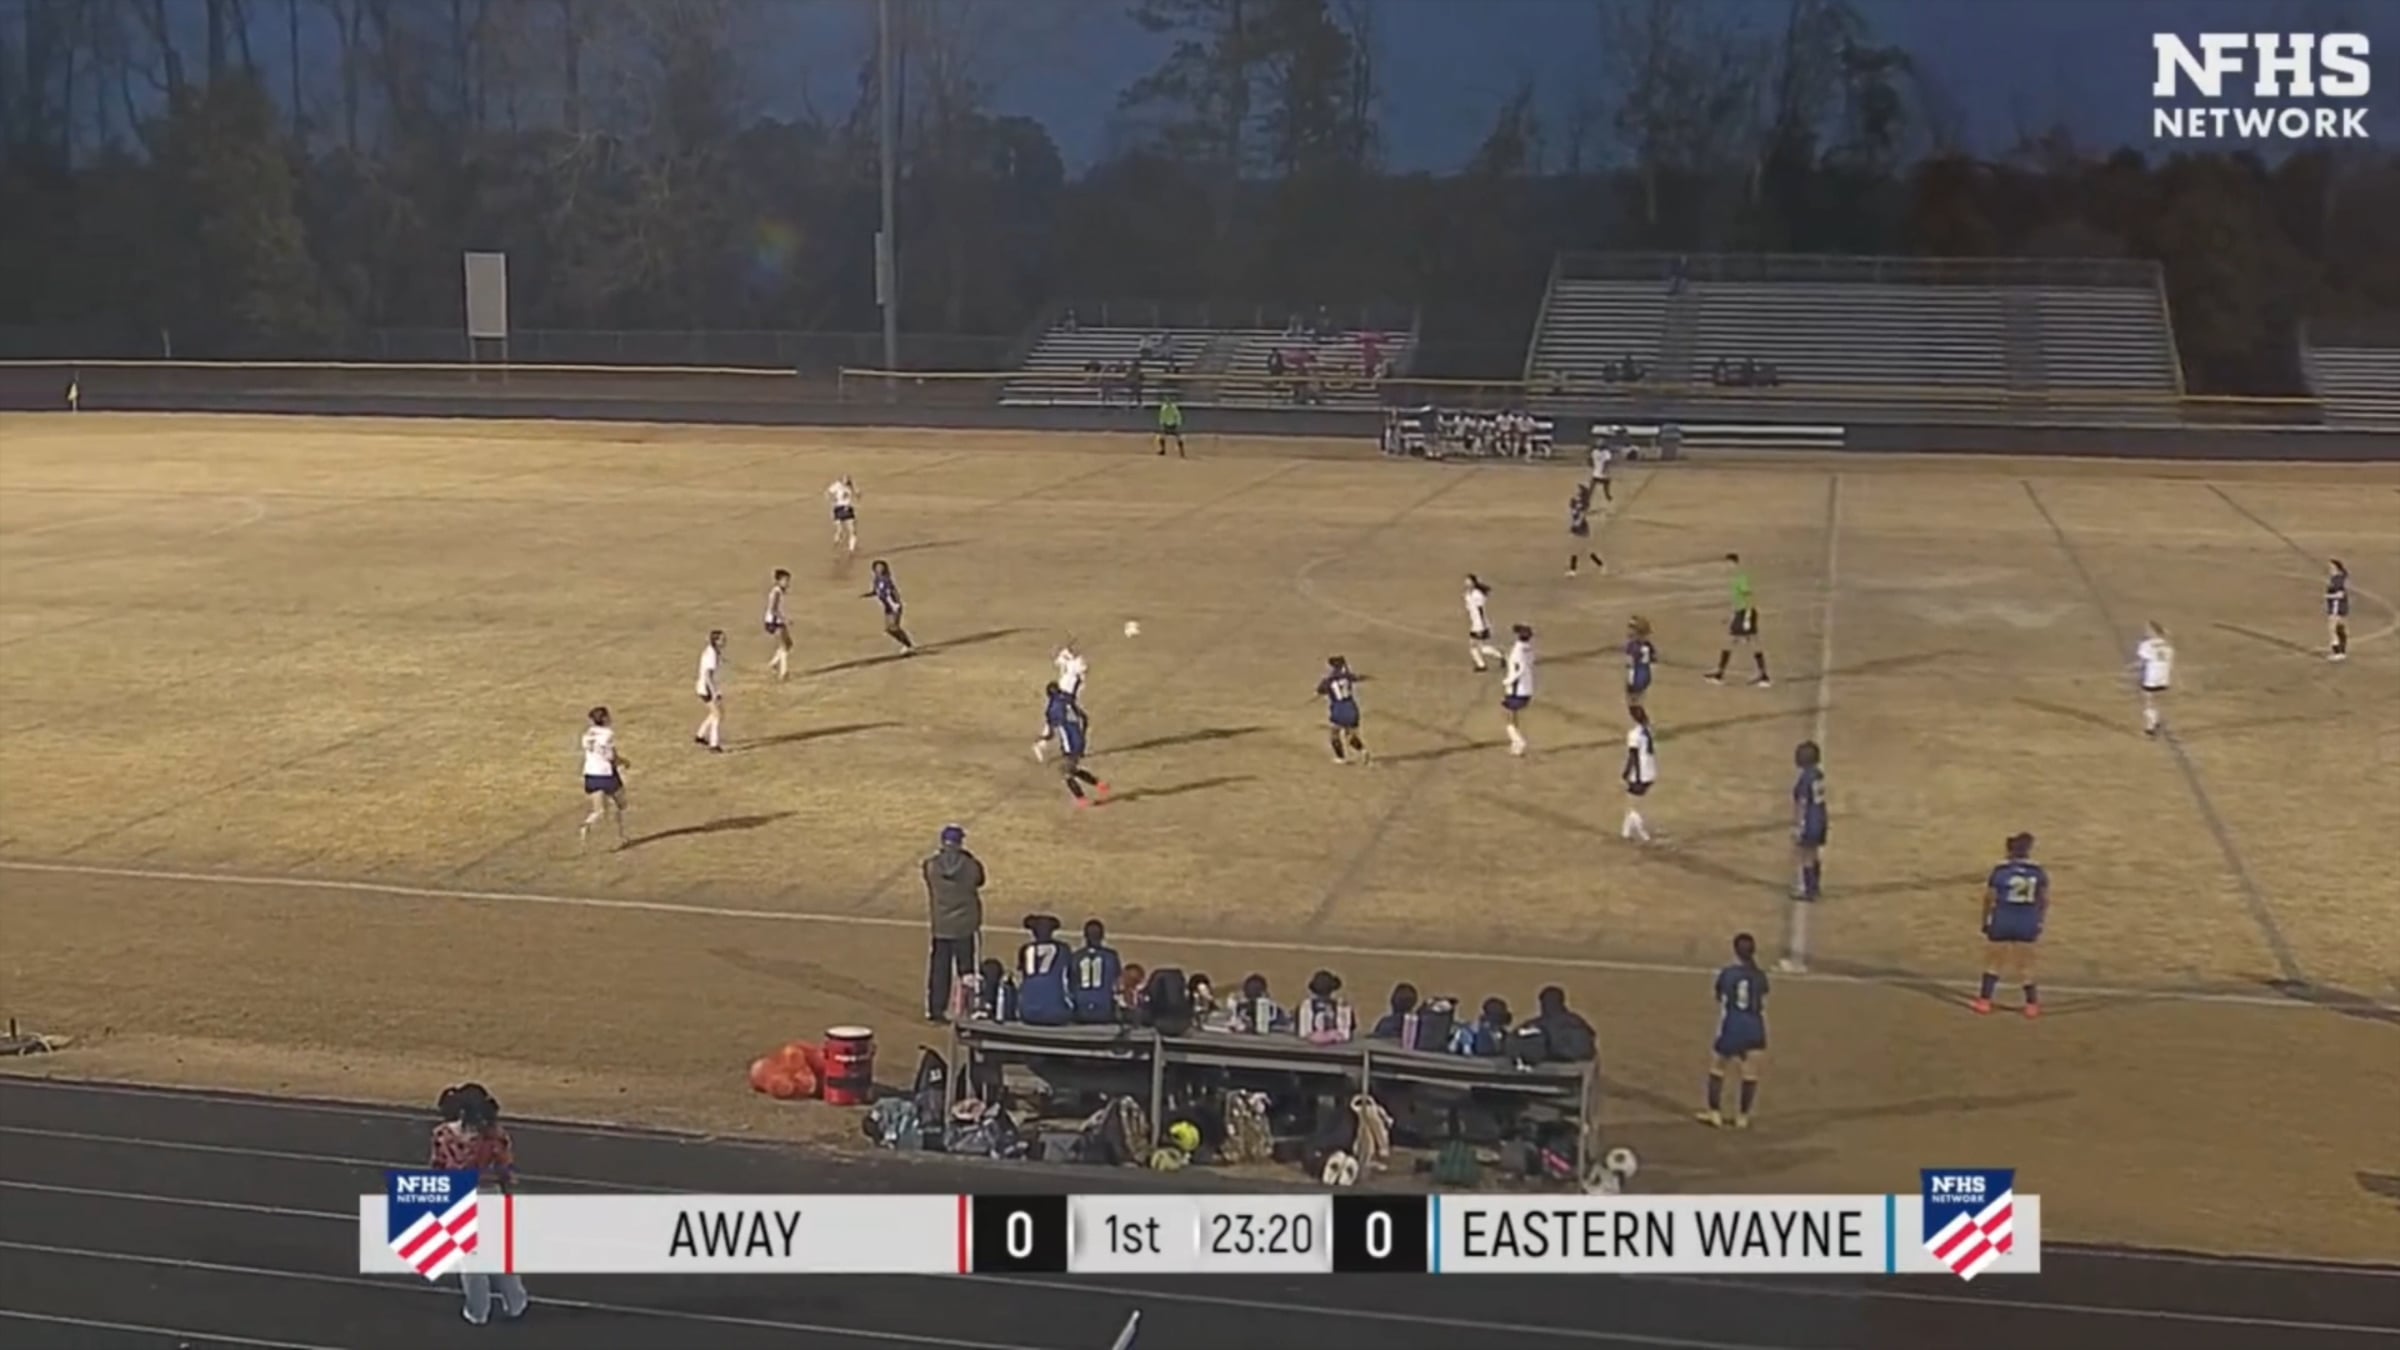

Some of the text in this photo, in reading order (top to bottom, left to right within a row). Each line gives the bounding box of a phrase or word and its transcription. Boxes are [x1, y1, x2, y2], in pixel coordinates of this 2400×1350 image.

[2007, 876, 2037, 903] 21
[1026, 944, 1057, 976] 17
[1080, 957, 1102, 988] 11
